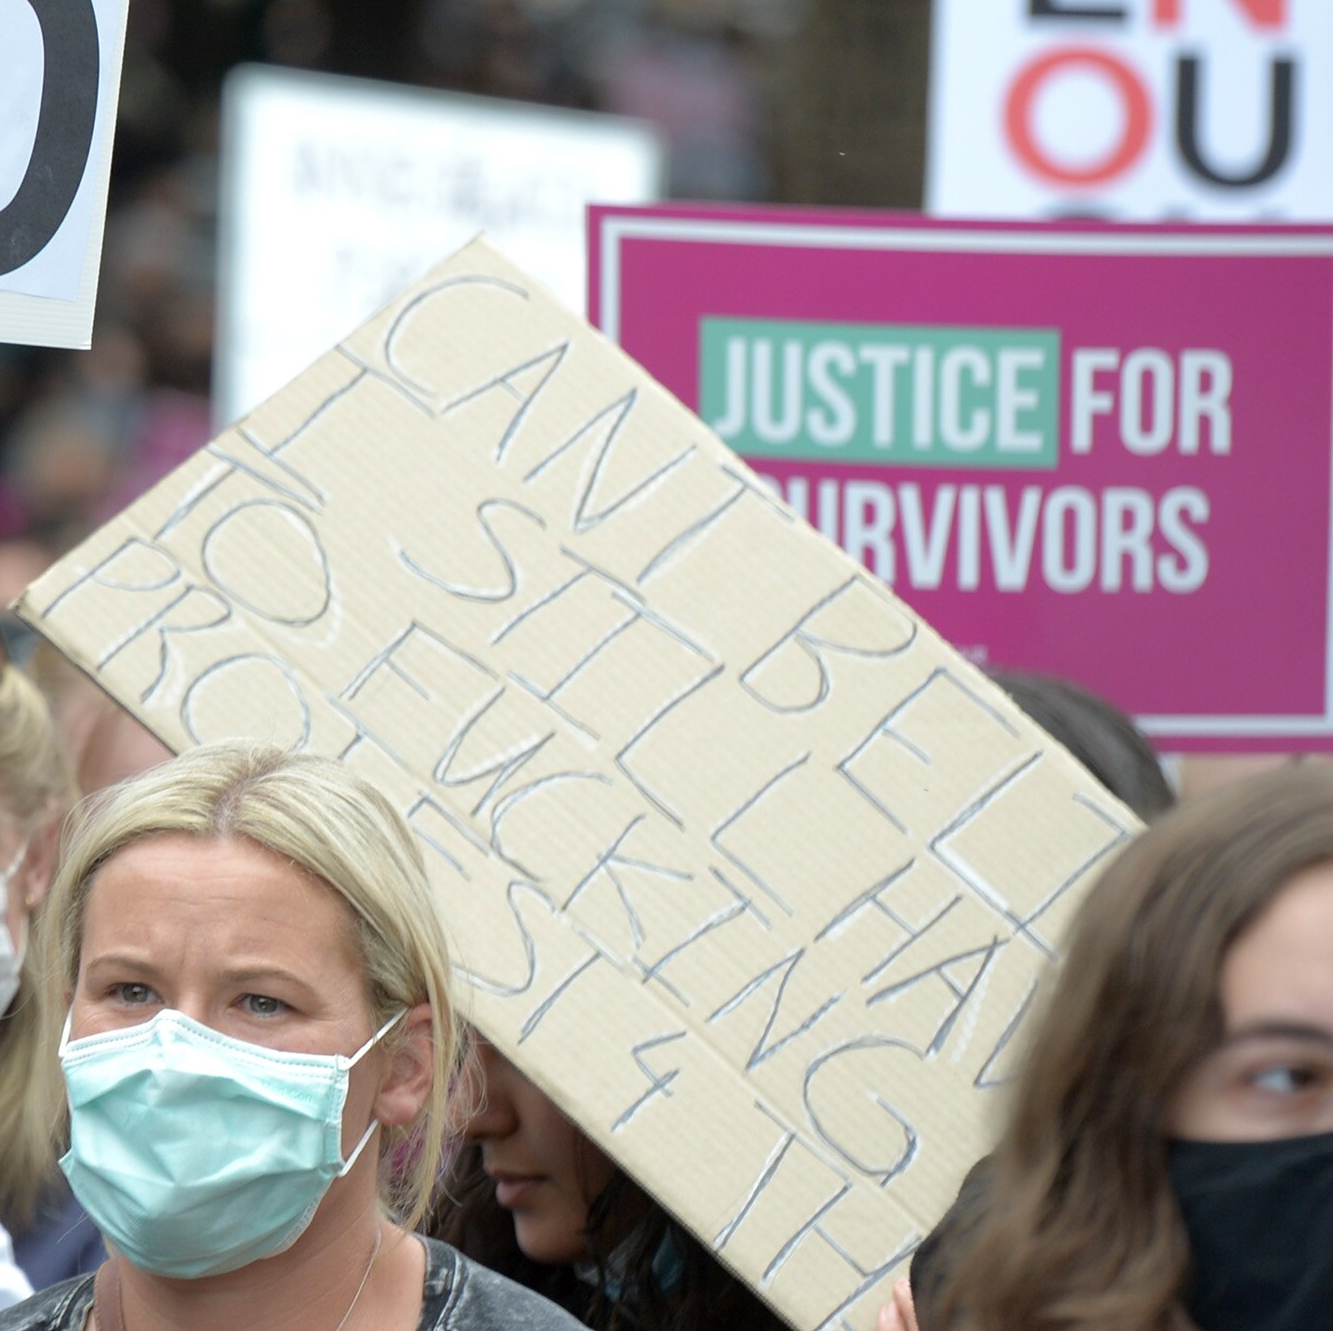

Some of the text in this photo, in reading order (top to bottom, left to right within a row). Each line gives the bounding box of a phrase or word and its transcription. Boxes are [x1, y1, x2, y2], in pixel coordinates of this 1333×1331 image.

[1004, 43, 1298, 191] OU
[385, 275, 795, 584] CANT
[711, 337, 1233, 456] JUSTICE FOR
[206, 442, 335, 629] TO
[341, 620, 925, 1187] FUCKING
[393, 498, 811, 917] STILL
[610, 1030, 688, 1132] 4
[713, 1099, 923, 1331] TH
